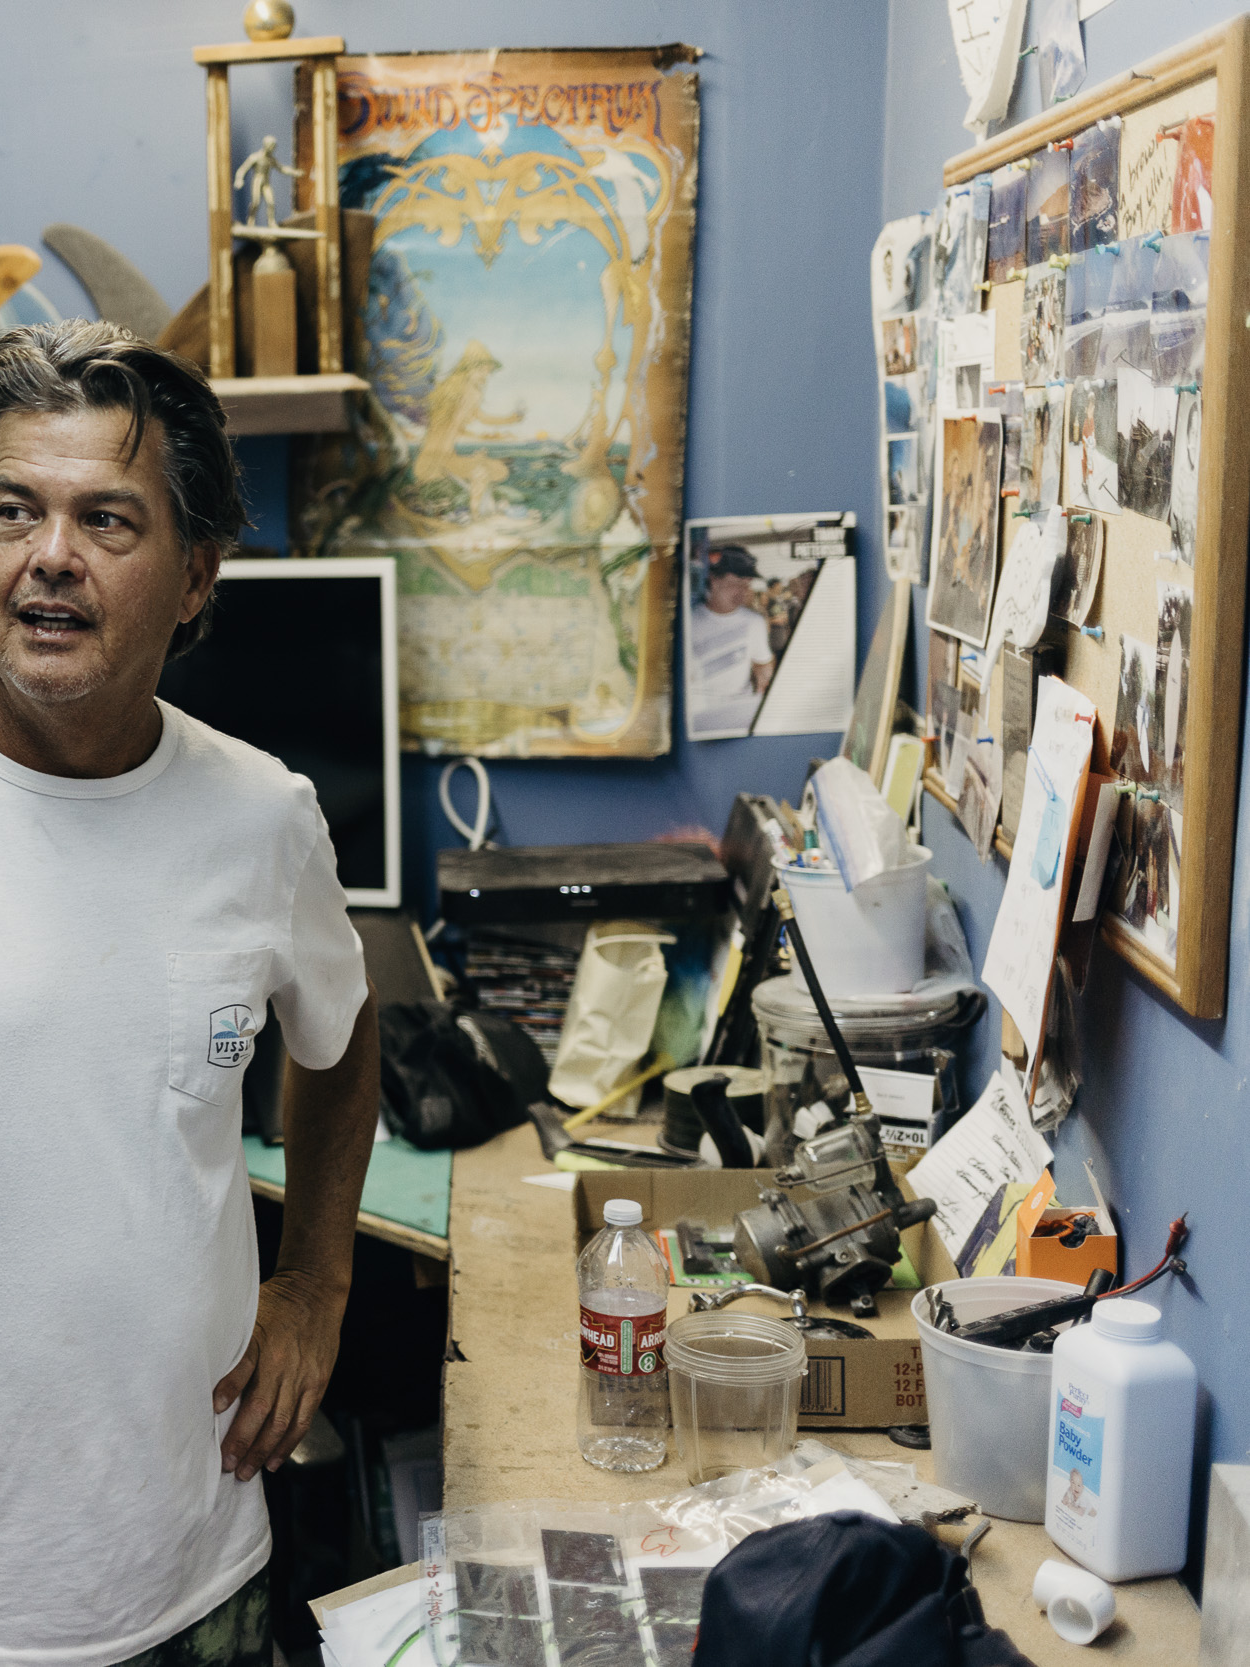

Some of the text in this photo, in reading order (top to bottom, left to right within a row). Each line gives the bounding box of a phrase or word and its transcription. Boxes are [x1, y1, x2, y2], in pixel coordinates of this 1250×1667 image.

[894, 1379, 910, 1391] 12
[1059, 1420, 1082, 1448] Baby
[1058, 1433, 1093, 1467] Powder
